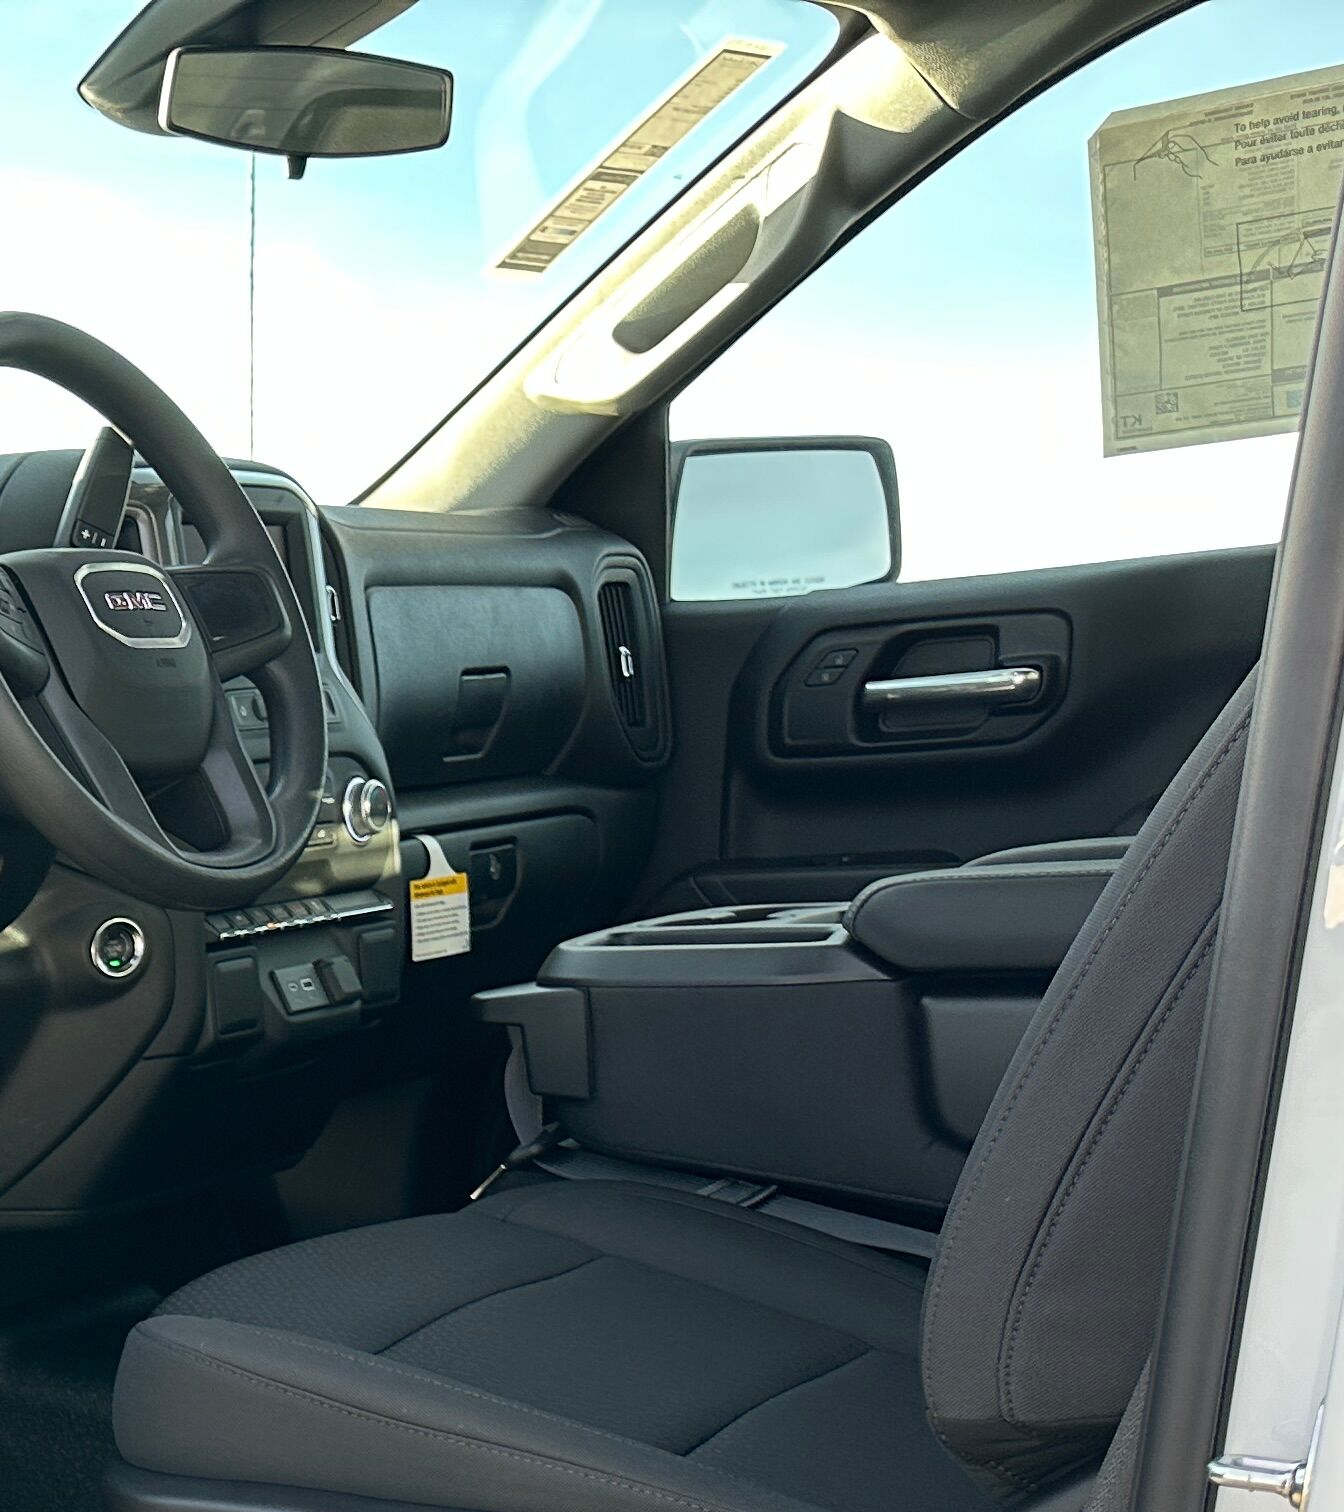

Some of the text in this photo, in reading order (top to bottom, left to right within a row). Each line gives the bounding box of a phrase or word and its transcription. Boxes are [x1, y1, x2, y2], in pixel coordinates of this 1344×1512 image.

[1234, 122, 1246, 133] To
[1248, 118, 1271, 130] help
[1272, 111, 1300, 126] avoid
[1234, 137, 1257, 151] Pour
[1235, 156, 1258, 167] Para
[1307, 145, 1314, 154] a
[104, 591, 166, 611] GMC
